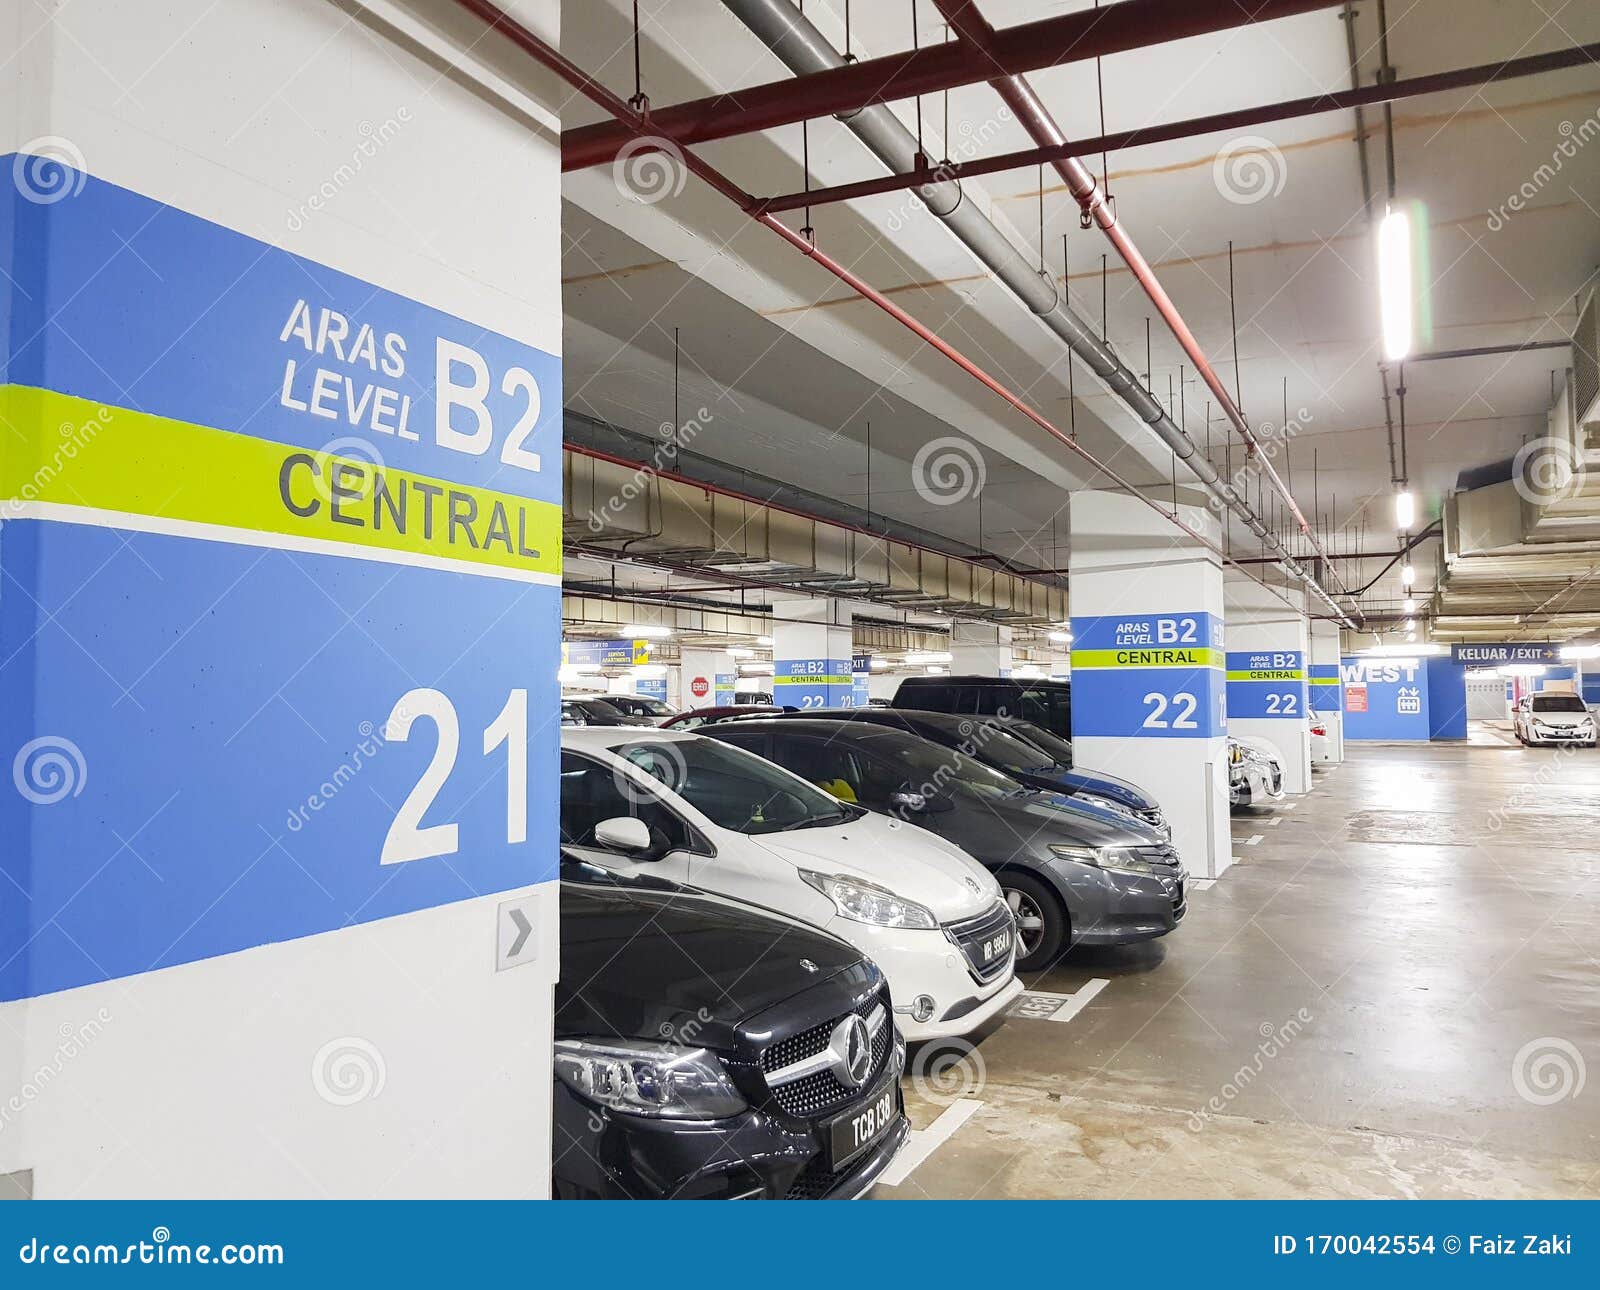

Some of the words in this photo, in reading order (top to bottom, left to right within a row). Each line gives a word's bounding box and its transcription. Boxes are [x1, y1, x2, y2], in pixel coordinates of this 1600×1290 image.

[279, 299, 407, 378] ARAS
[281, 359, 419, 441] LEVEL
[436, 336, 541, 472] B2
[279, 453, 541, 558] CENTRAL
[1116, 623, 1149, 633] ARAS
[1157, 618, 1197, 643] B2
[1116, 634, 1154, 645] LEVEL
[1117, 651, 1197, 664] CENTRAL
[1273, 653, 1296, 668] B2
[1458, 647, 1507, 660] KELUAR
[1517, 648, 1542, 659] EXIT
[807, 661, 824, 674] B2
[852, 659, 864, 668] XIT
[1340, 664, 1419, 682] WEST
[802, 695, 824, 708] 22
[1142, 692, 1198, 729] 22
[1265, 693, 1297, 714] 22
[380, 688, 528, 865] 21
[852, 1108, 875, 1147] TCB
[876, 1093, 890, 1129] 138
